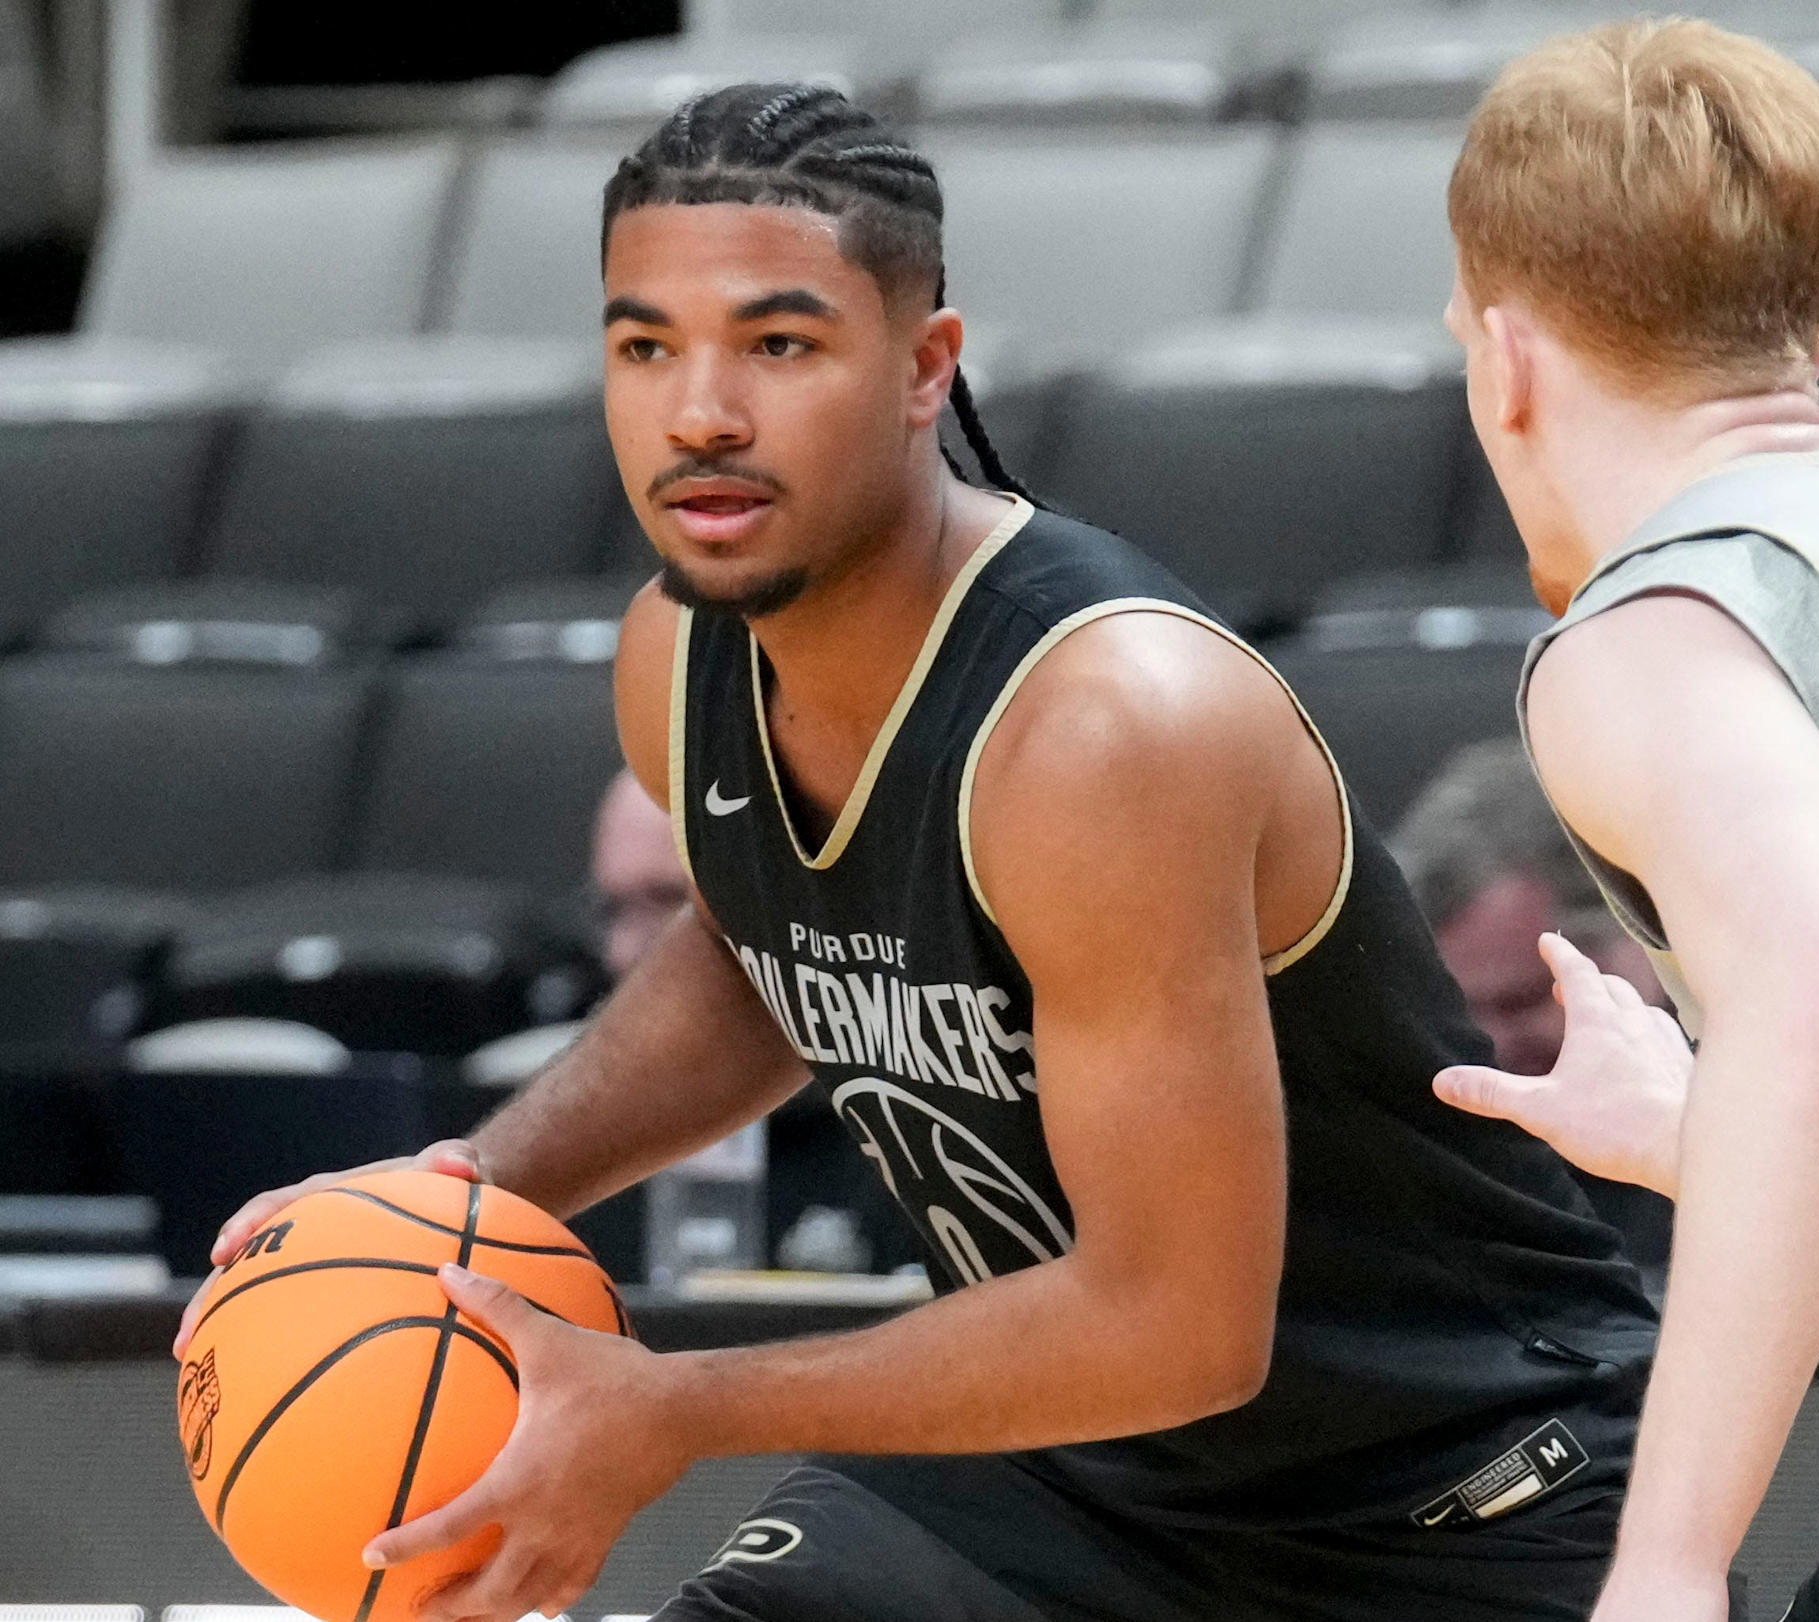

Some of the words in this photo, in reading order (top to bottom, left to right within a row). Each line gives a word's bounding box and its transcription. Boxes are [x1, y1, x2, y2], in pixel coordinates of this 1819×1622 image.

[789, 921, 906, 970] PURDUE
[723, 933, 1039, 1101] OILERMAKERS
[1538, 1437, 1569, 1468] M
